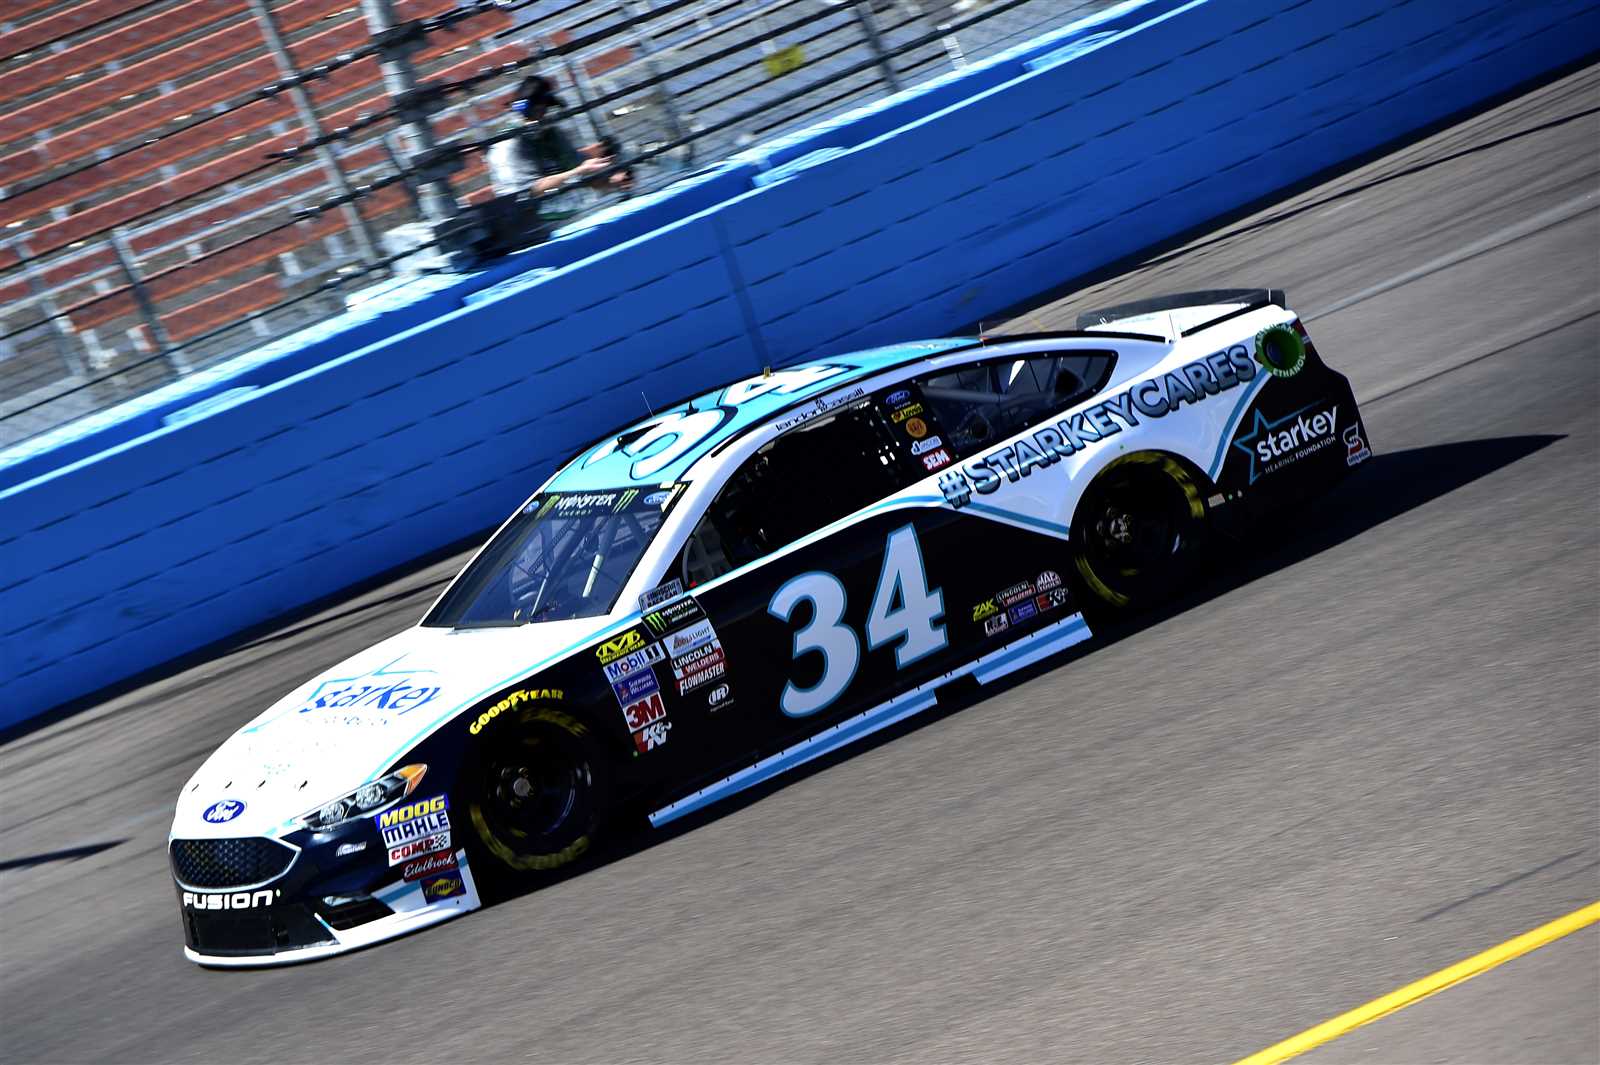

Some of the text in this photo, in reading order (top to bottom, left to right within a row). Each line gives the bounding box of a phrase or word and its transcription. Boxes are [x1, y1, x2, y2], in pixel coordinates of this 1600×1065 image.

[1273, 354, 1306, 377] ETHANOL
[937, 345, 1256, 509] #STARKEYCARES
[1257, 406, 1337, 462] starkey
[923, 449, 950, 470] SEM
[1295, 436, 1336, 460] FOUNDATION
[554, 493, 617, 510] MONSTER
[559, 509, 593, 517] ENERGY
[974, 598, 994, 616] ZAK
[767, 522, 949, 718] 34
[607, 652, 645, 678] Mobil
[673, 645, 713, 668] LINCOLN
[686, 653, 720, 674] WELDERS
[680, 662, 725, 696] FLOWMASTER
[469, 688, 564, 735] GOODYEAR
[626, 694, 666, 728] 3M
[380, 794, 445, 828] MOOG
[384, 813, 448, 845] MAHLE
[391, 836, 435, 860] COMP
[404, 852, 455, 878] Edelbrock
[183, 889, 274, 911] FUSION
